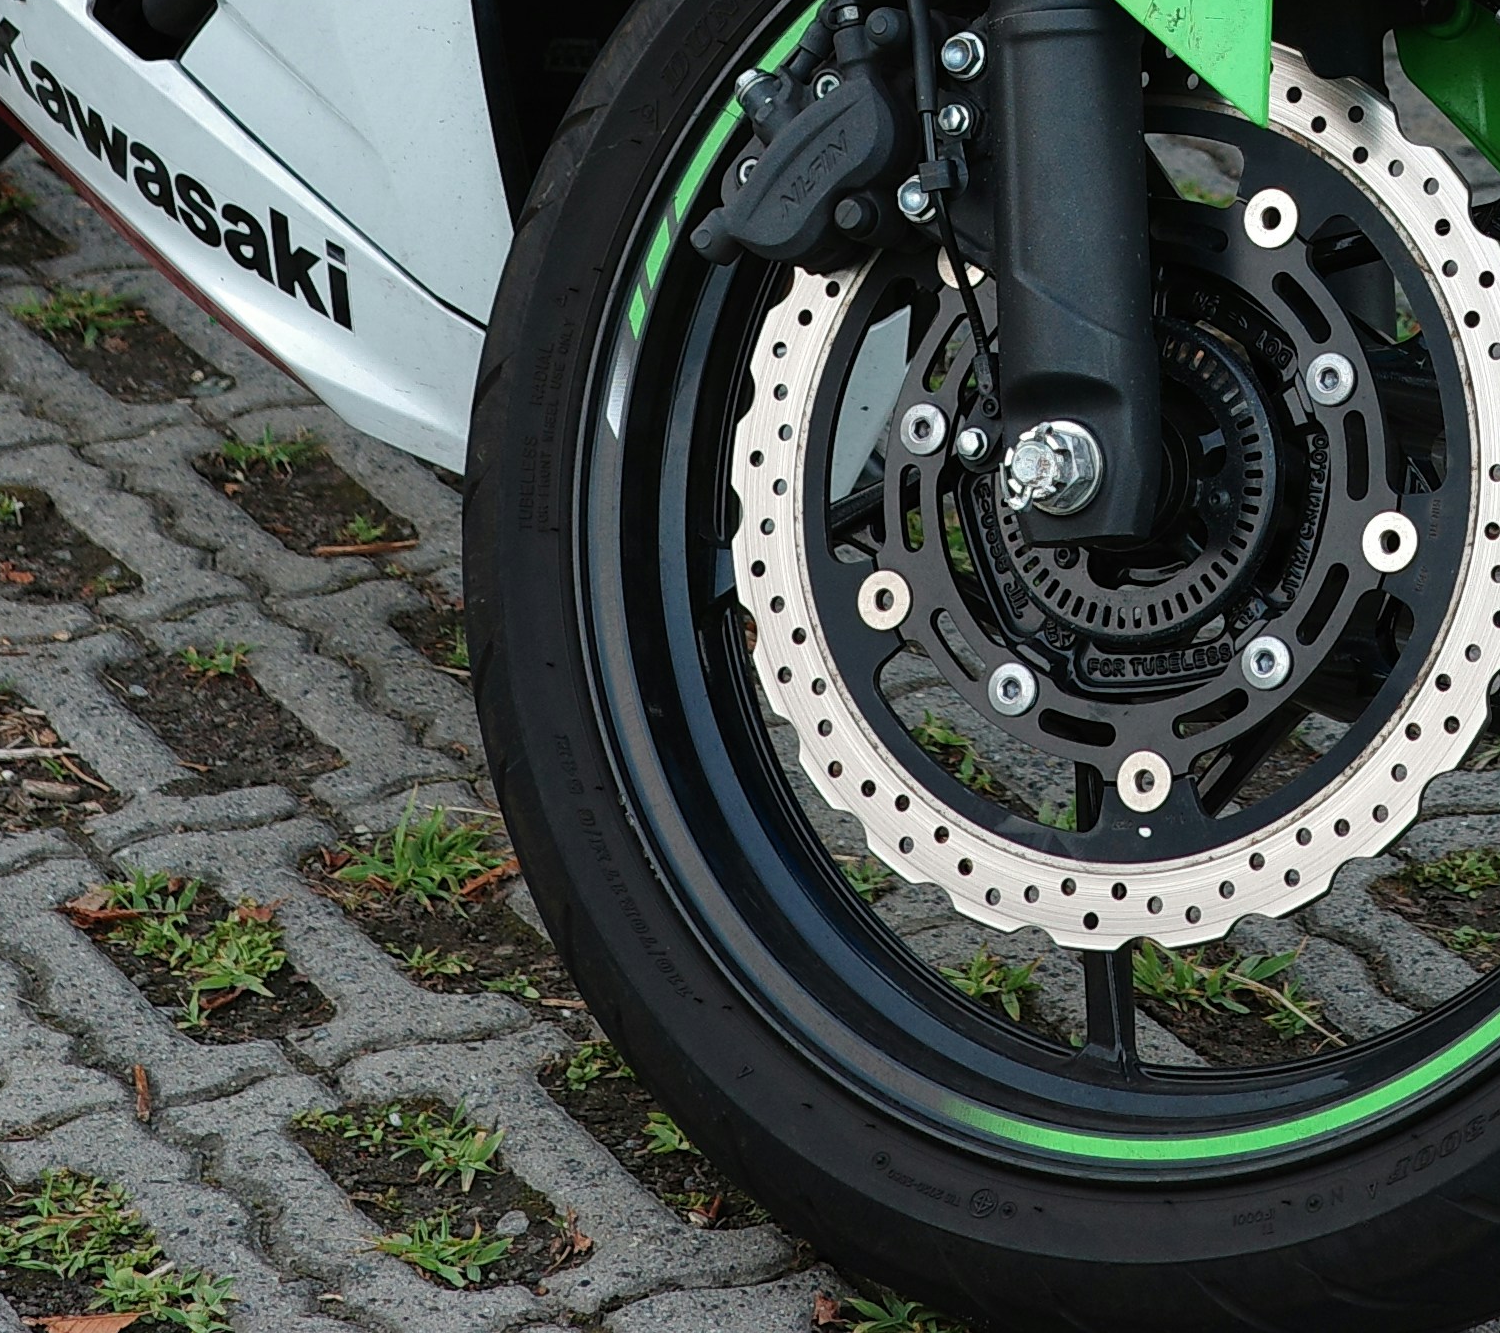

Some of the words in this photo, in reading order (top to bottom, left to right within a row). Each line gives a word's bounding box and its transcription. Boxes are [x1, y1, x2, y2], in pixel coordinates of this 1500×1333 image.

[518, 435, 538, 532] TUBELESS
[529, 342, 555, 405] RADIAL
[1086, 655, 1127, 678] FOR
[1130, 644, 1233, 678] TUBELESS
